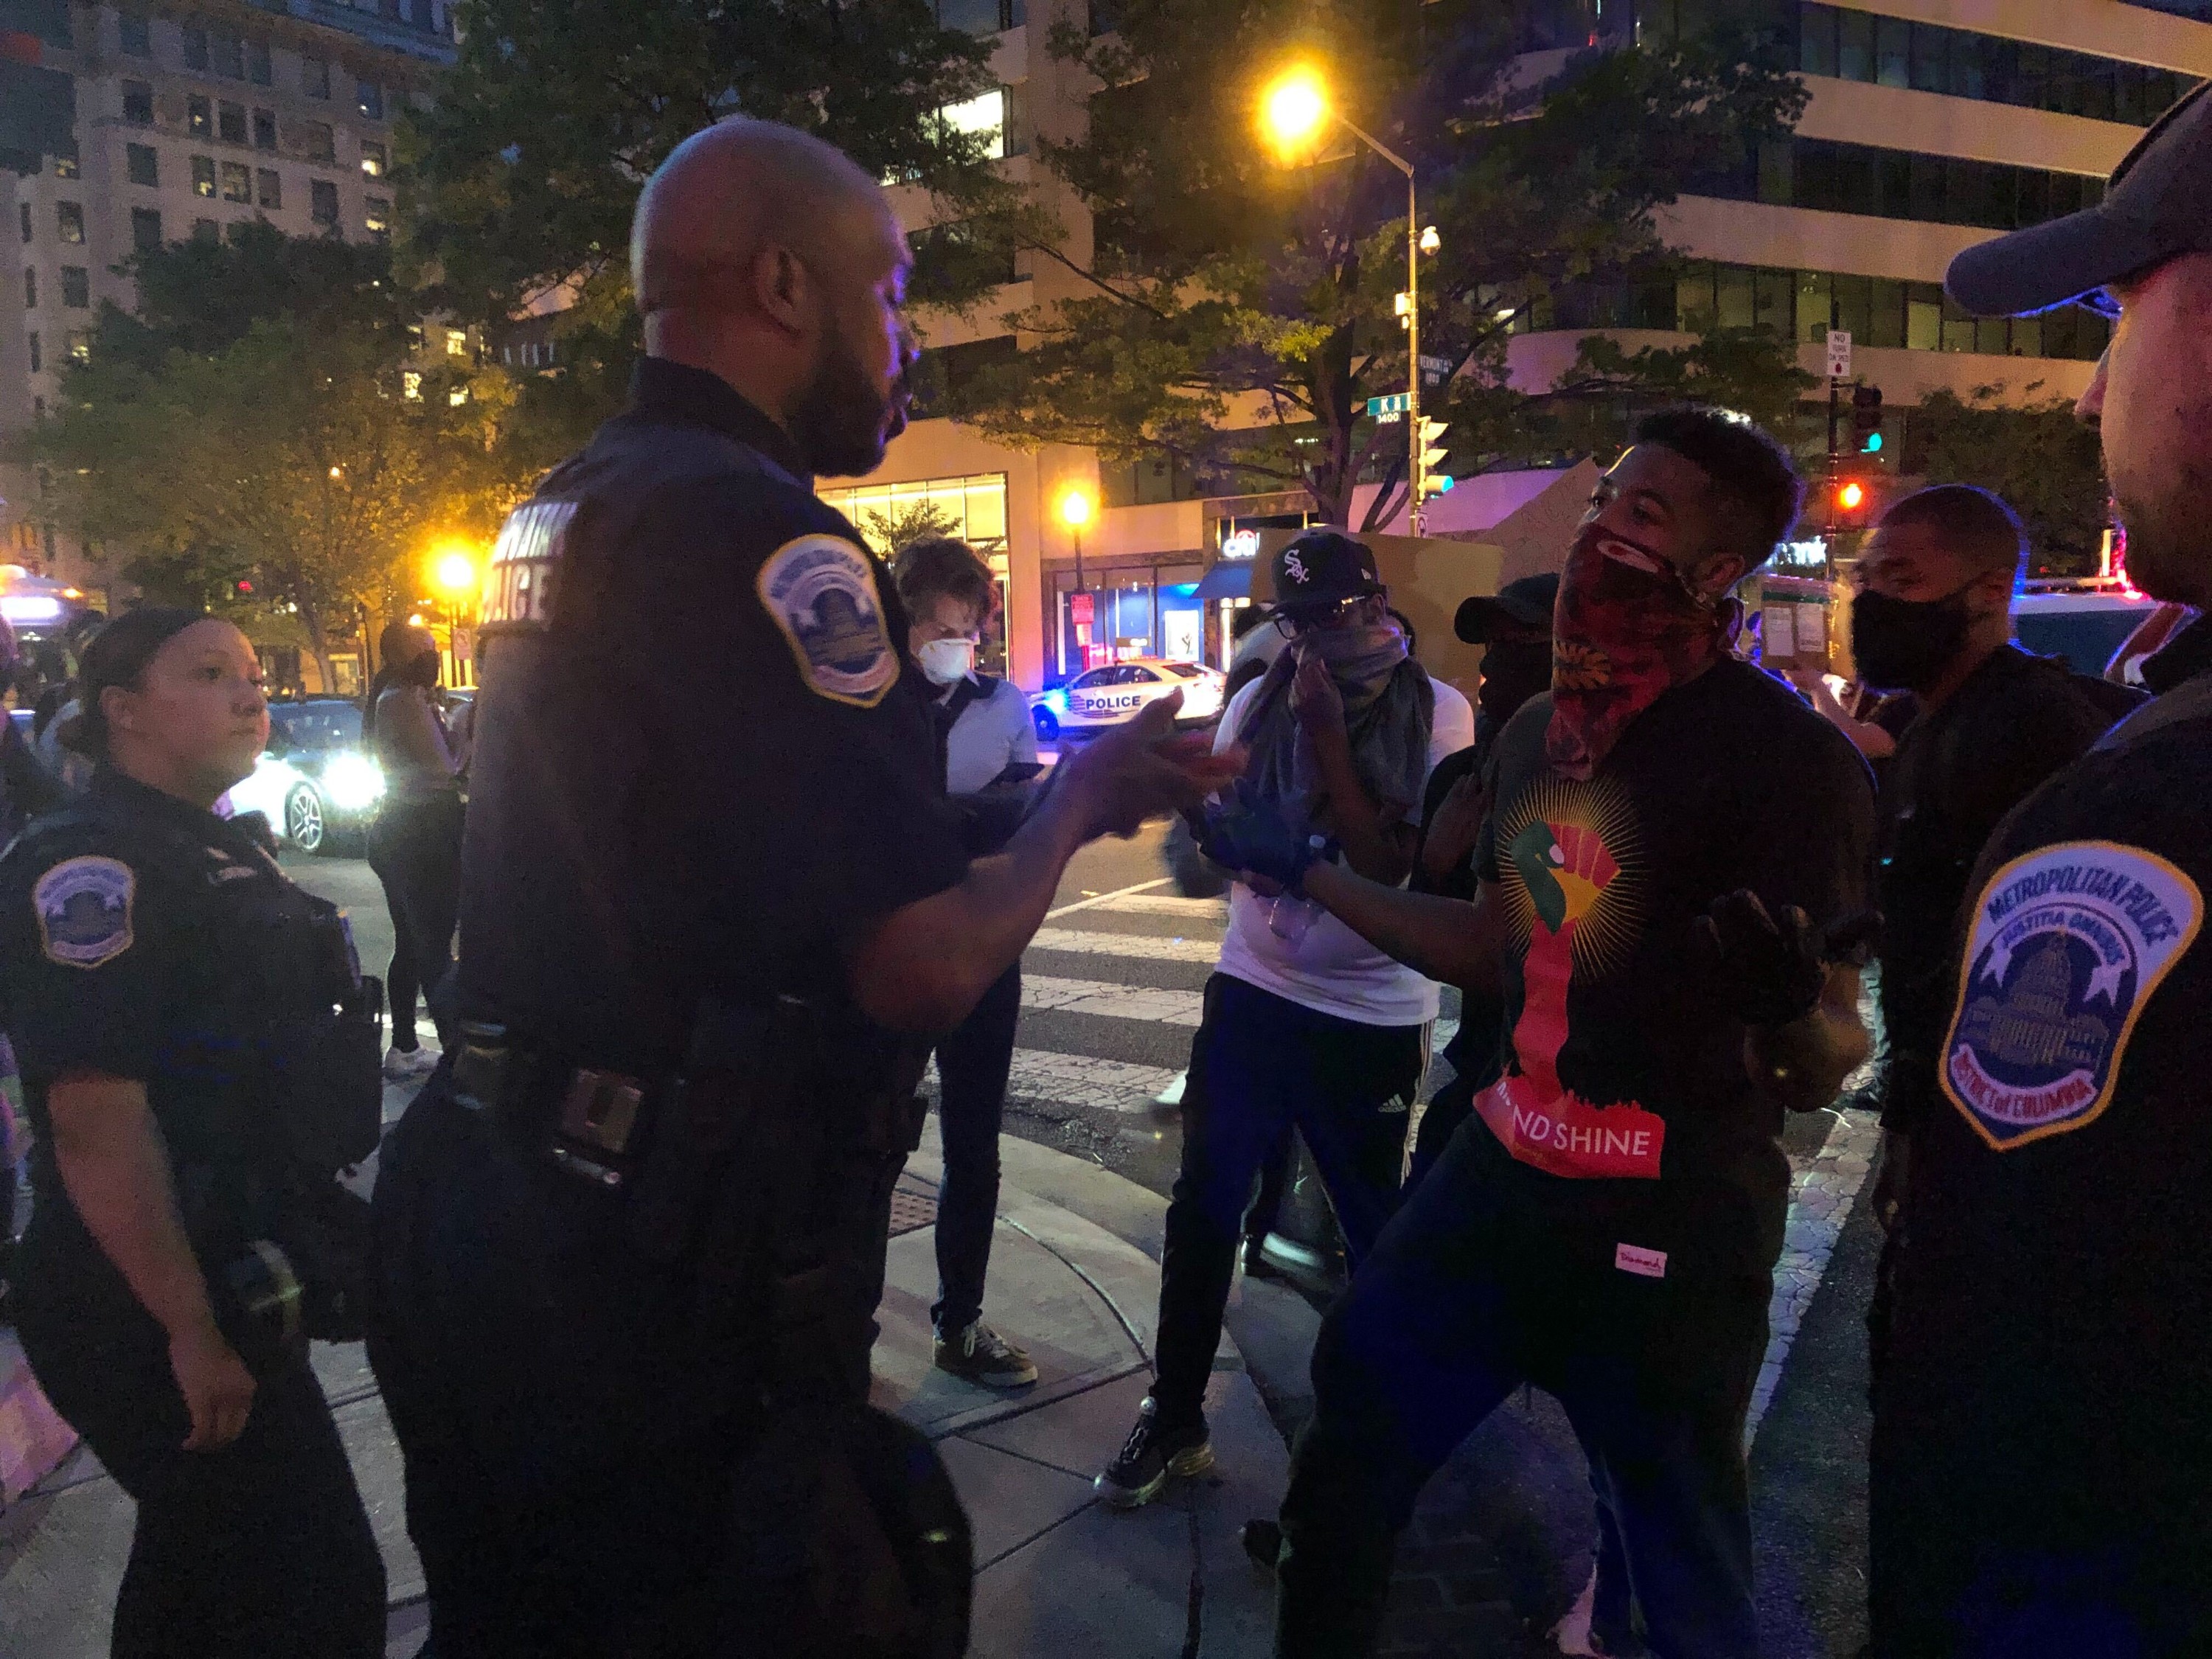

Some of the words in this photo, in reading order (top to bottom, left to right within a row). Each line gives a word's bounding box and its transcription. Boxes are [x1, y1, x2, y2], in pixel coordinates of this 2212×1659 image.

[1834, 334, 1846, 343] NO
[1381, 397, 1388, 414] K
[1378, 412, 1399, 423] 1400
[1085, 695, 1141, 709] POLICE
[1988, 865, 2129, 924] METROPOLITAN
[2116, 880, 2180, 947] POLICE
[1512, 1104, 1550, 1141] ND
[1554, 1122, 1651, 1156] SHINE
